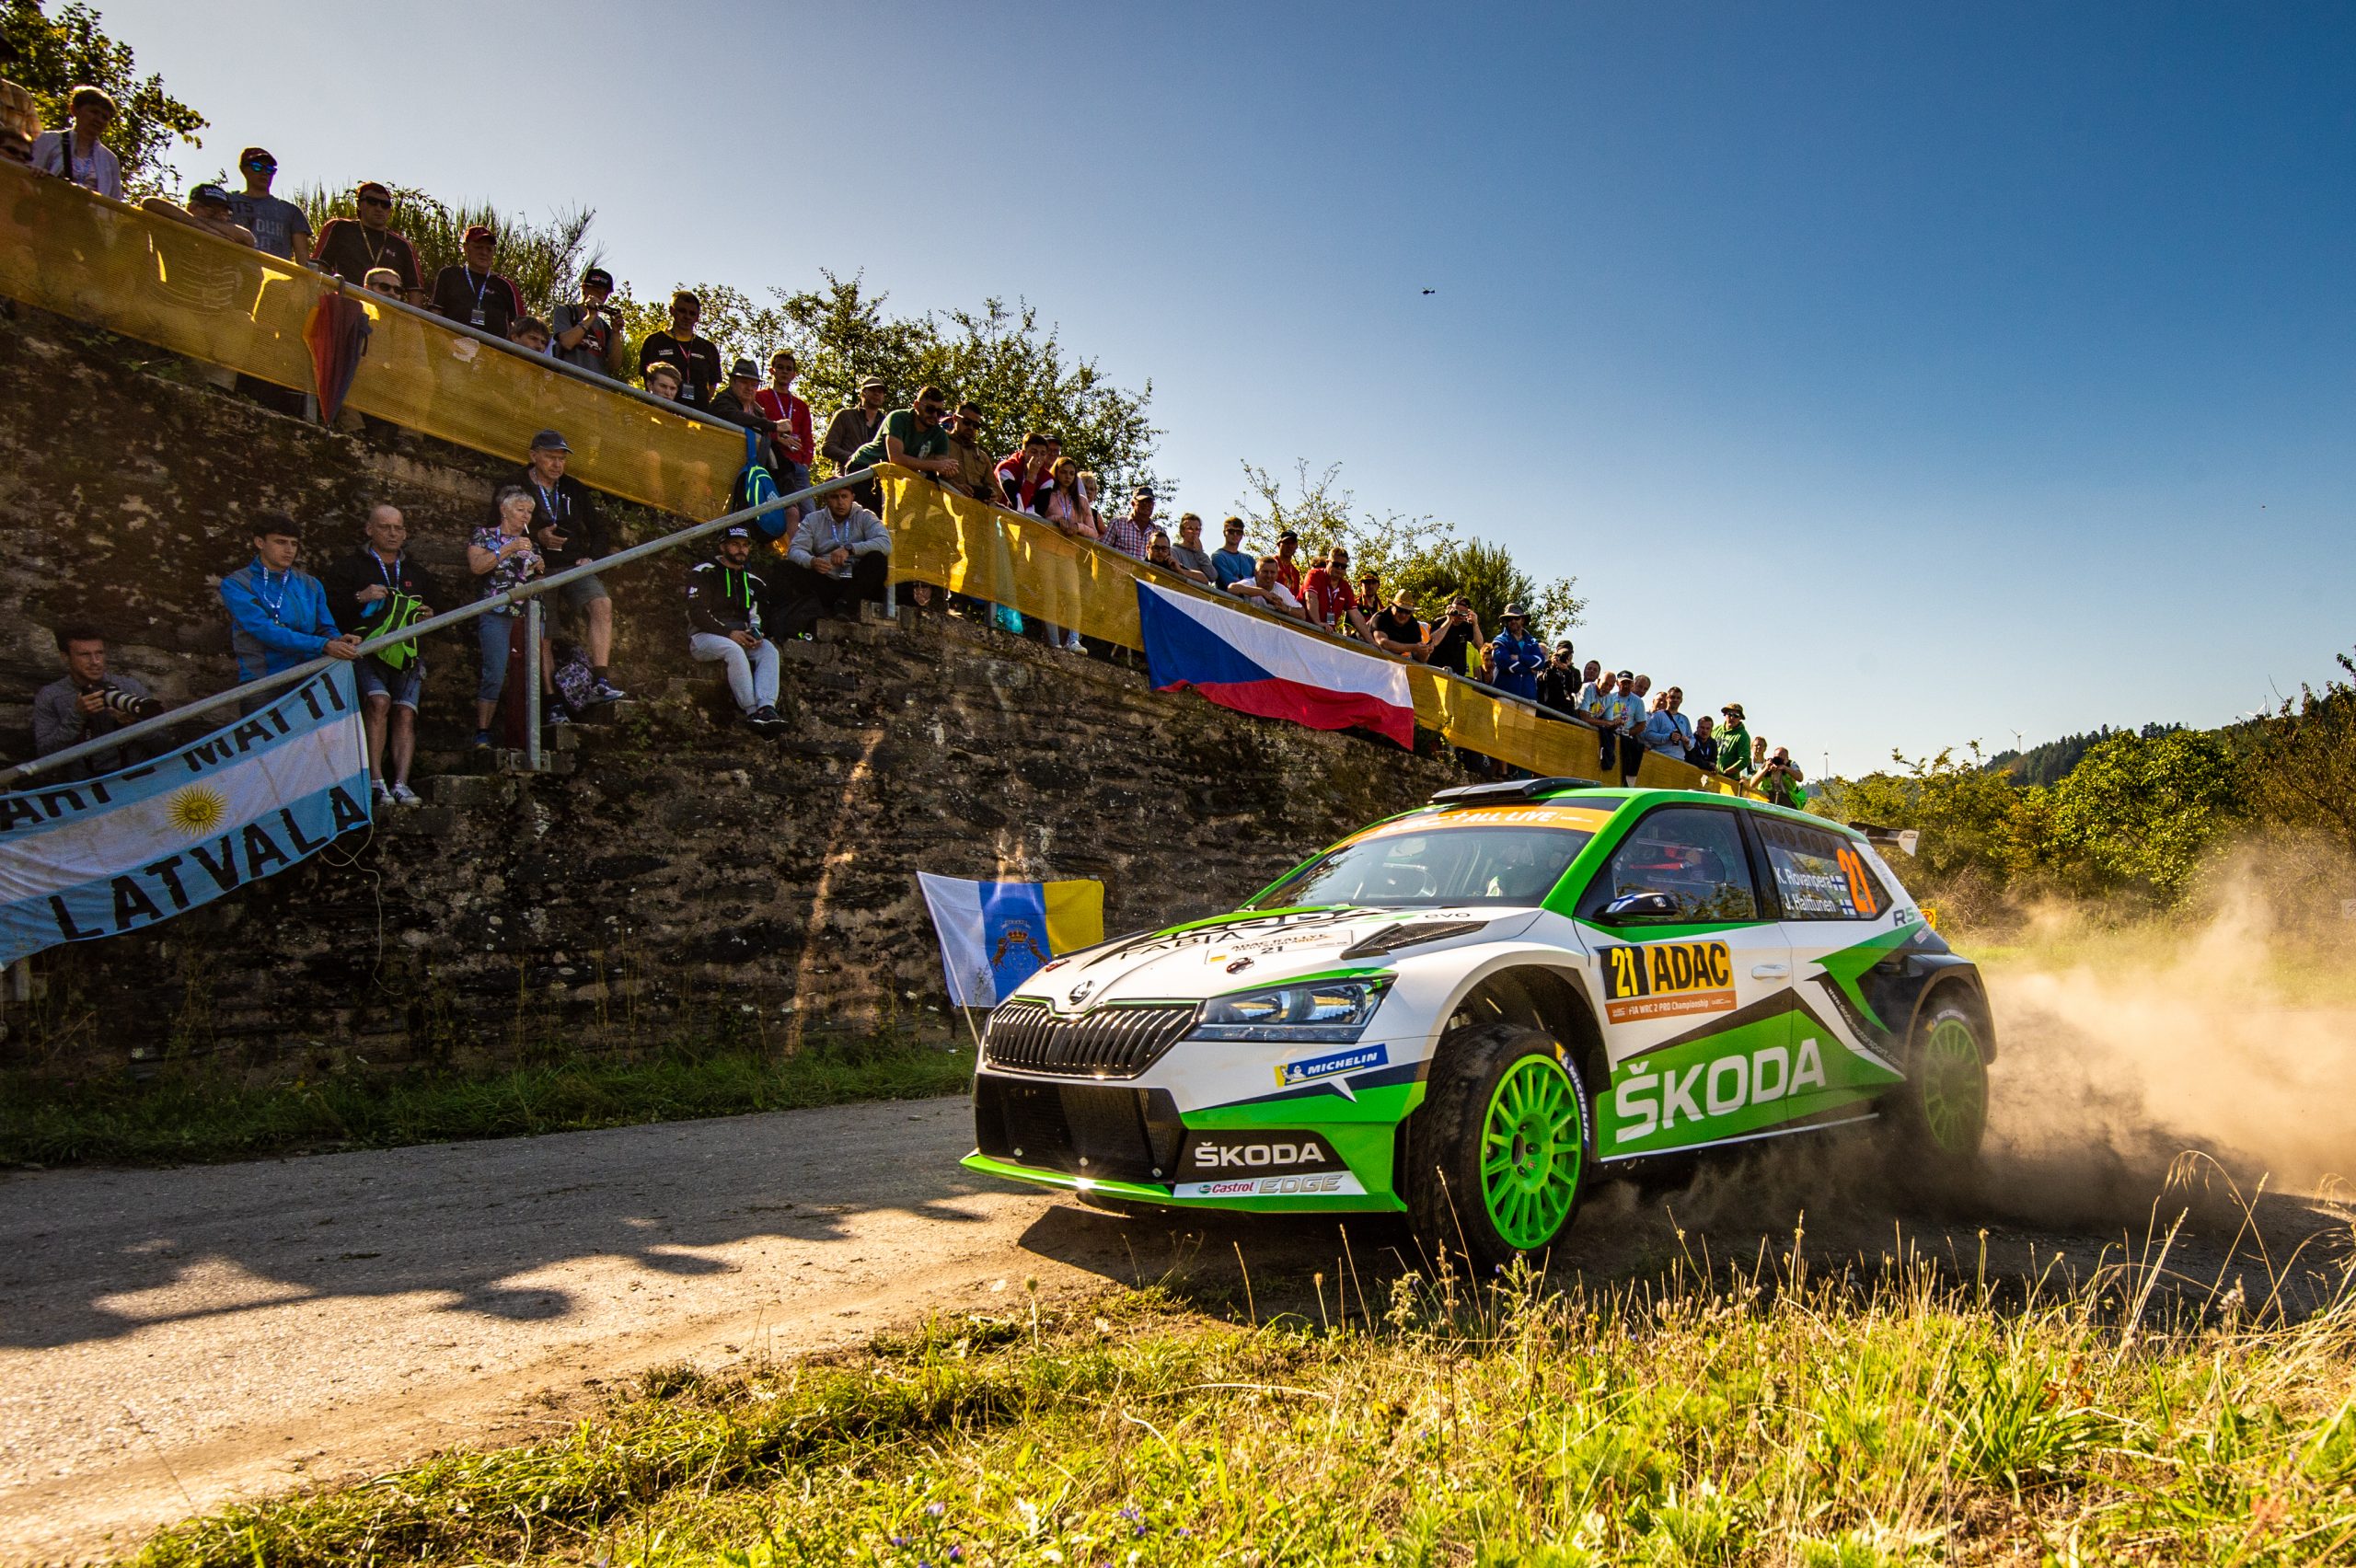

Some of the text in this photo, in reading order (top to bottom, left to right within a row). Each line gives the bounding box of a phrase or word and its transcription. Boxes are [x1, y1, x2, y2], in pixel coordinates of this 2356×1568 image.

[1504, 811, 1557, 822] LIVE
[48, 787, 368, 941] LATVALA
[1774, 867, 1786, 885] K.
[1836, 847, 1877, 914] 21
[1795, 894, 1837, 913] Halttunen
[1120, 930, 1244, 960] FABIA
[1261, 946, 1284, 955] 21
[1611, 943, 1729, 997] 21 ADAC
[1640, 1003, 1653, 1014] WRC
[1672, 998, 1709, 1011] Championship
[1308, 1052, 1378, 1075] MICHELIN
[1616, 1038, 1826, 1144] ŠKODA
[1568, 1065, 1589, 1142] MICHELIN
[1195, 1141, 1326, 1167] ŠKODA
[1211, 1174, 1344, 1194] Castrol EDGE
